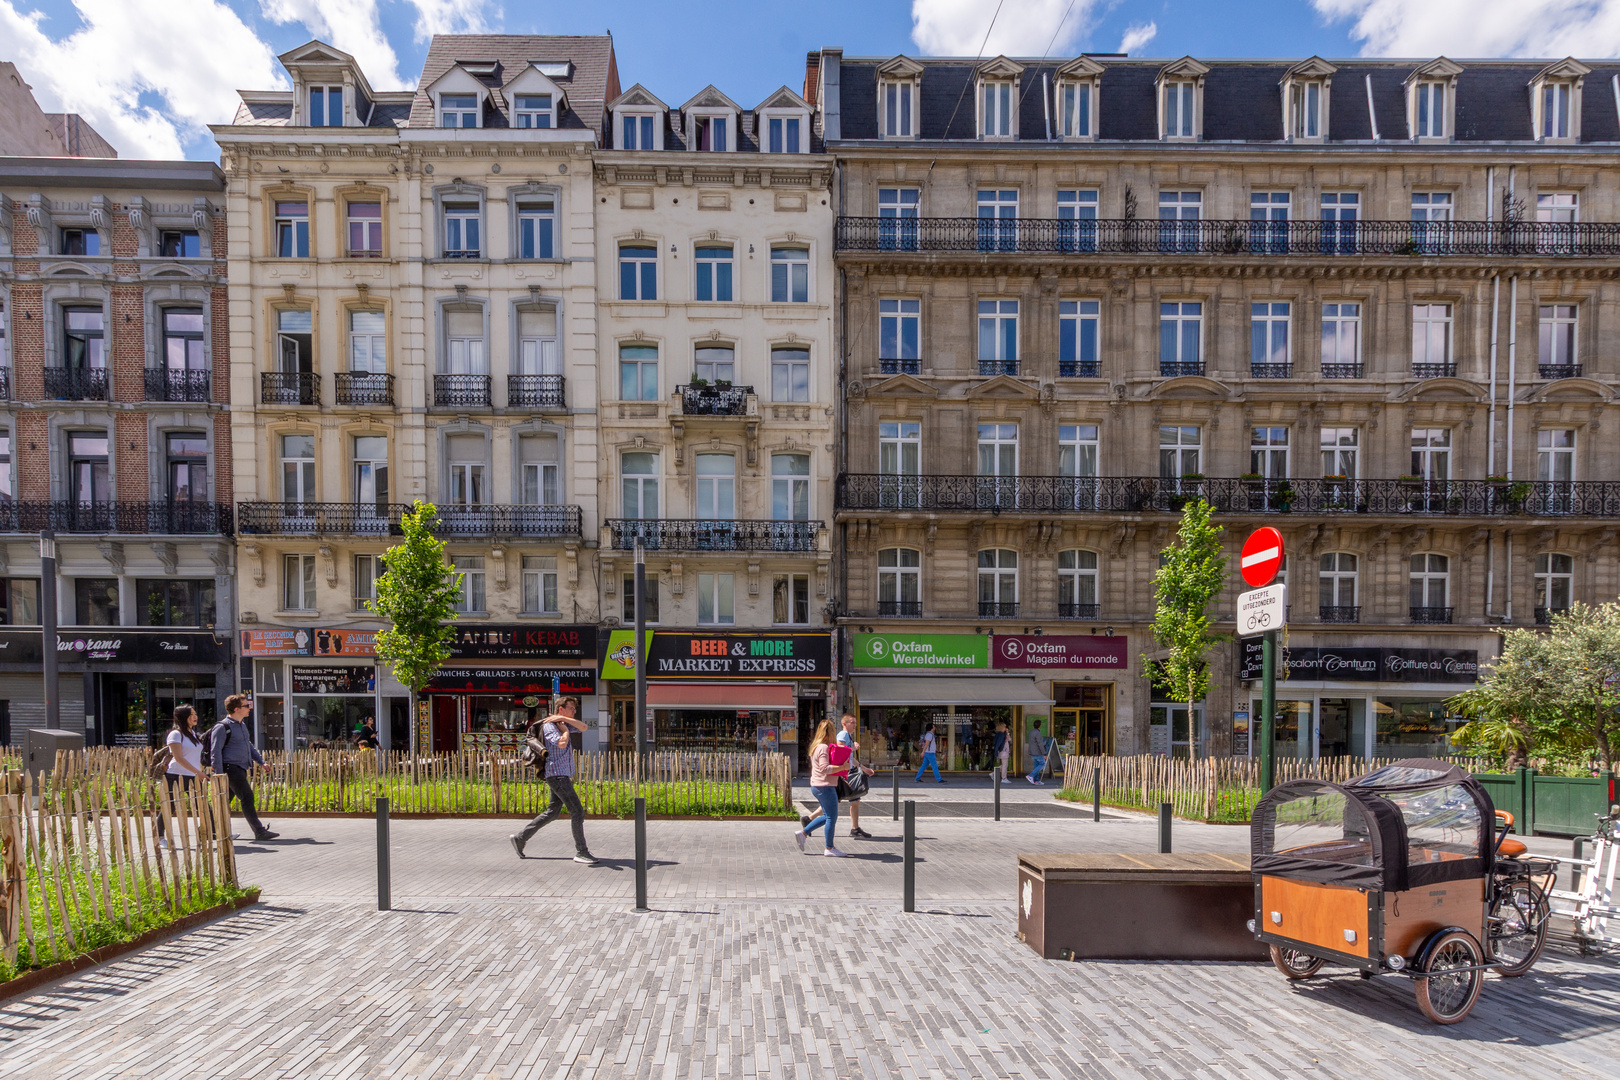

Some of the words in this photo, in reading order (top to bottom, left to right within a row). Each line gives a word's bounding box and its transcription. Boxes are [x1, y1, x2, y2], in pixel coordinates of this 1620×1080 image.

[1249, 590, 1269, 601] EXCEPTE
[1243, 597, 1275, 611] UITGEZONDERD
[263, 631, 295, 640] SECONDE
[437, 631, 521, 645] TANBUL
[526, 631, 579, 645] KEBAB
[265, 640, 283, 648] MAIN
[690, 639, 728, 656] BEER
[731, 642, 747, 656] &
[750, 639, 794, 656] MORE
[892, 641, 933, 652] Oxfam
[1026, 642, 1066, 653] Oxfam
[1246, 644, 1263, 652] COIFF
[892, 653, 975, 665] Wereldwinkel
[1026, 654, 1067, 666] Magasin
[1070, 654, 1083, 665] du
[1085, 654, 1118, 665] monde
[1323, 654, 1376, 672] Centrum
[1388, 655, 1428, 672] Coiffure
[1429, 660, 1442, 669] du
[1442, 657, 1476, 673] Centre
[659, 658, 732, 672] MARKET
[738, 658, 816, 672] EXPRESS
[1248, 662, 1263, 671] CENT
[475, 670, 516, 678] GRILLADES
[521, 670, 543, 678] PLATS
[543, 670, 549, 678] A
[550, 670, 590, 678] EMPORTER
